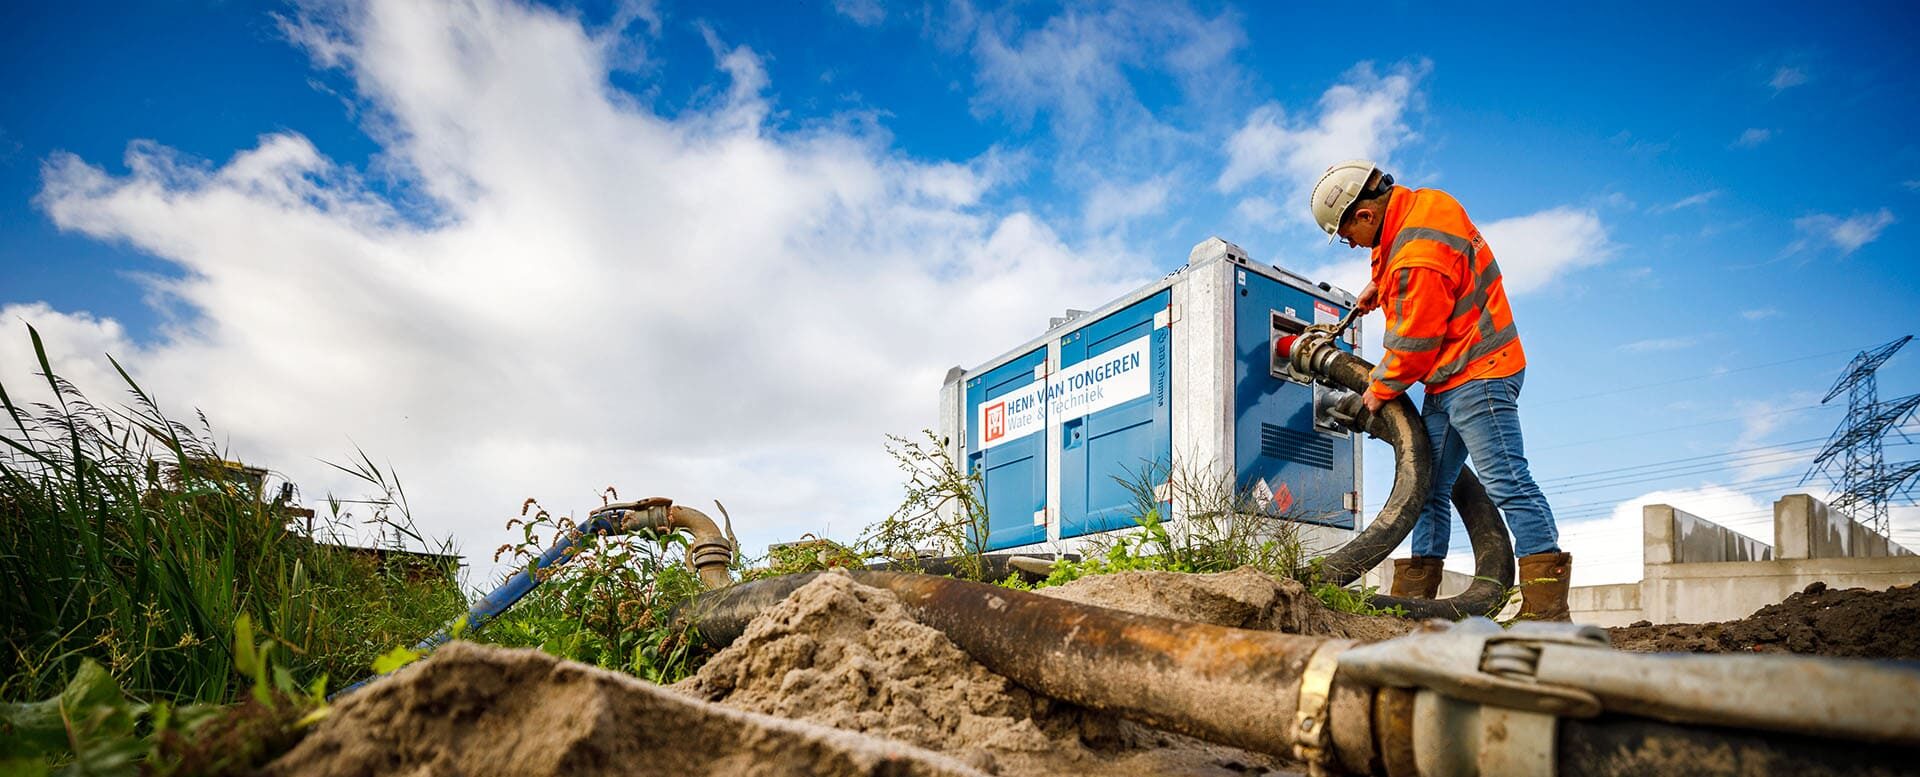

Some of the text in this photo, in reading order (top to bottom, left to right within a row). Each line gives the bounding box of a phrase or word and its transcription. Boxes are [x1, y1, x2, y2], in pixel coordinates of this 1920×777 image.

[1037, 380, 1064, 404] VAN
[1068, 351, 1140, 392] TONGEREN
[1008, 384, 1104, 431] Wate & Techniek
